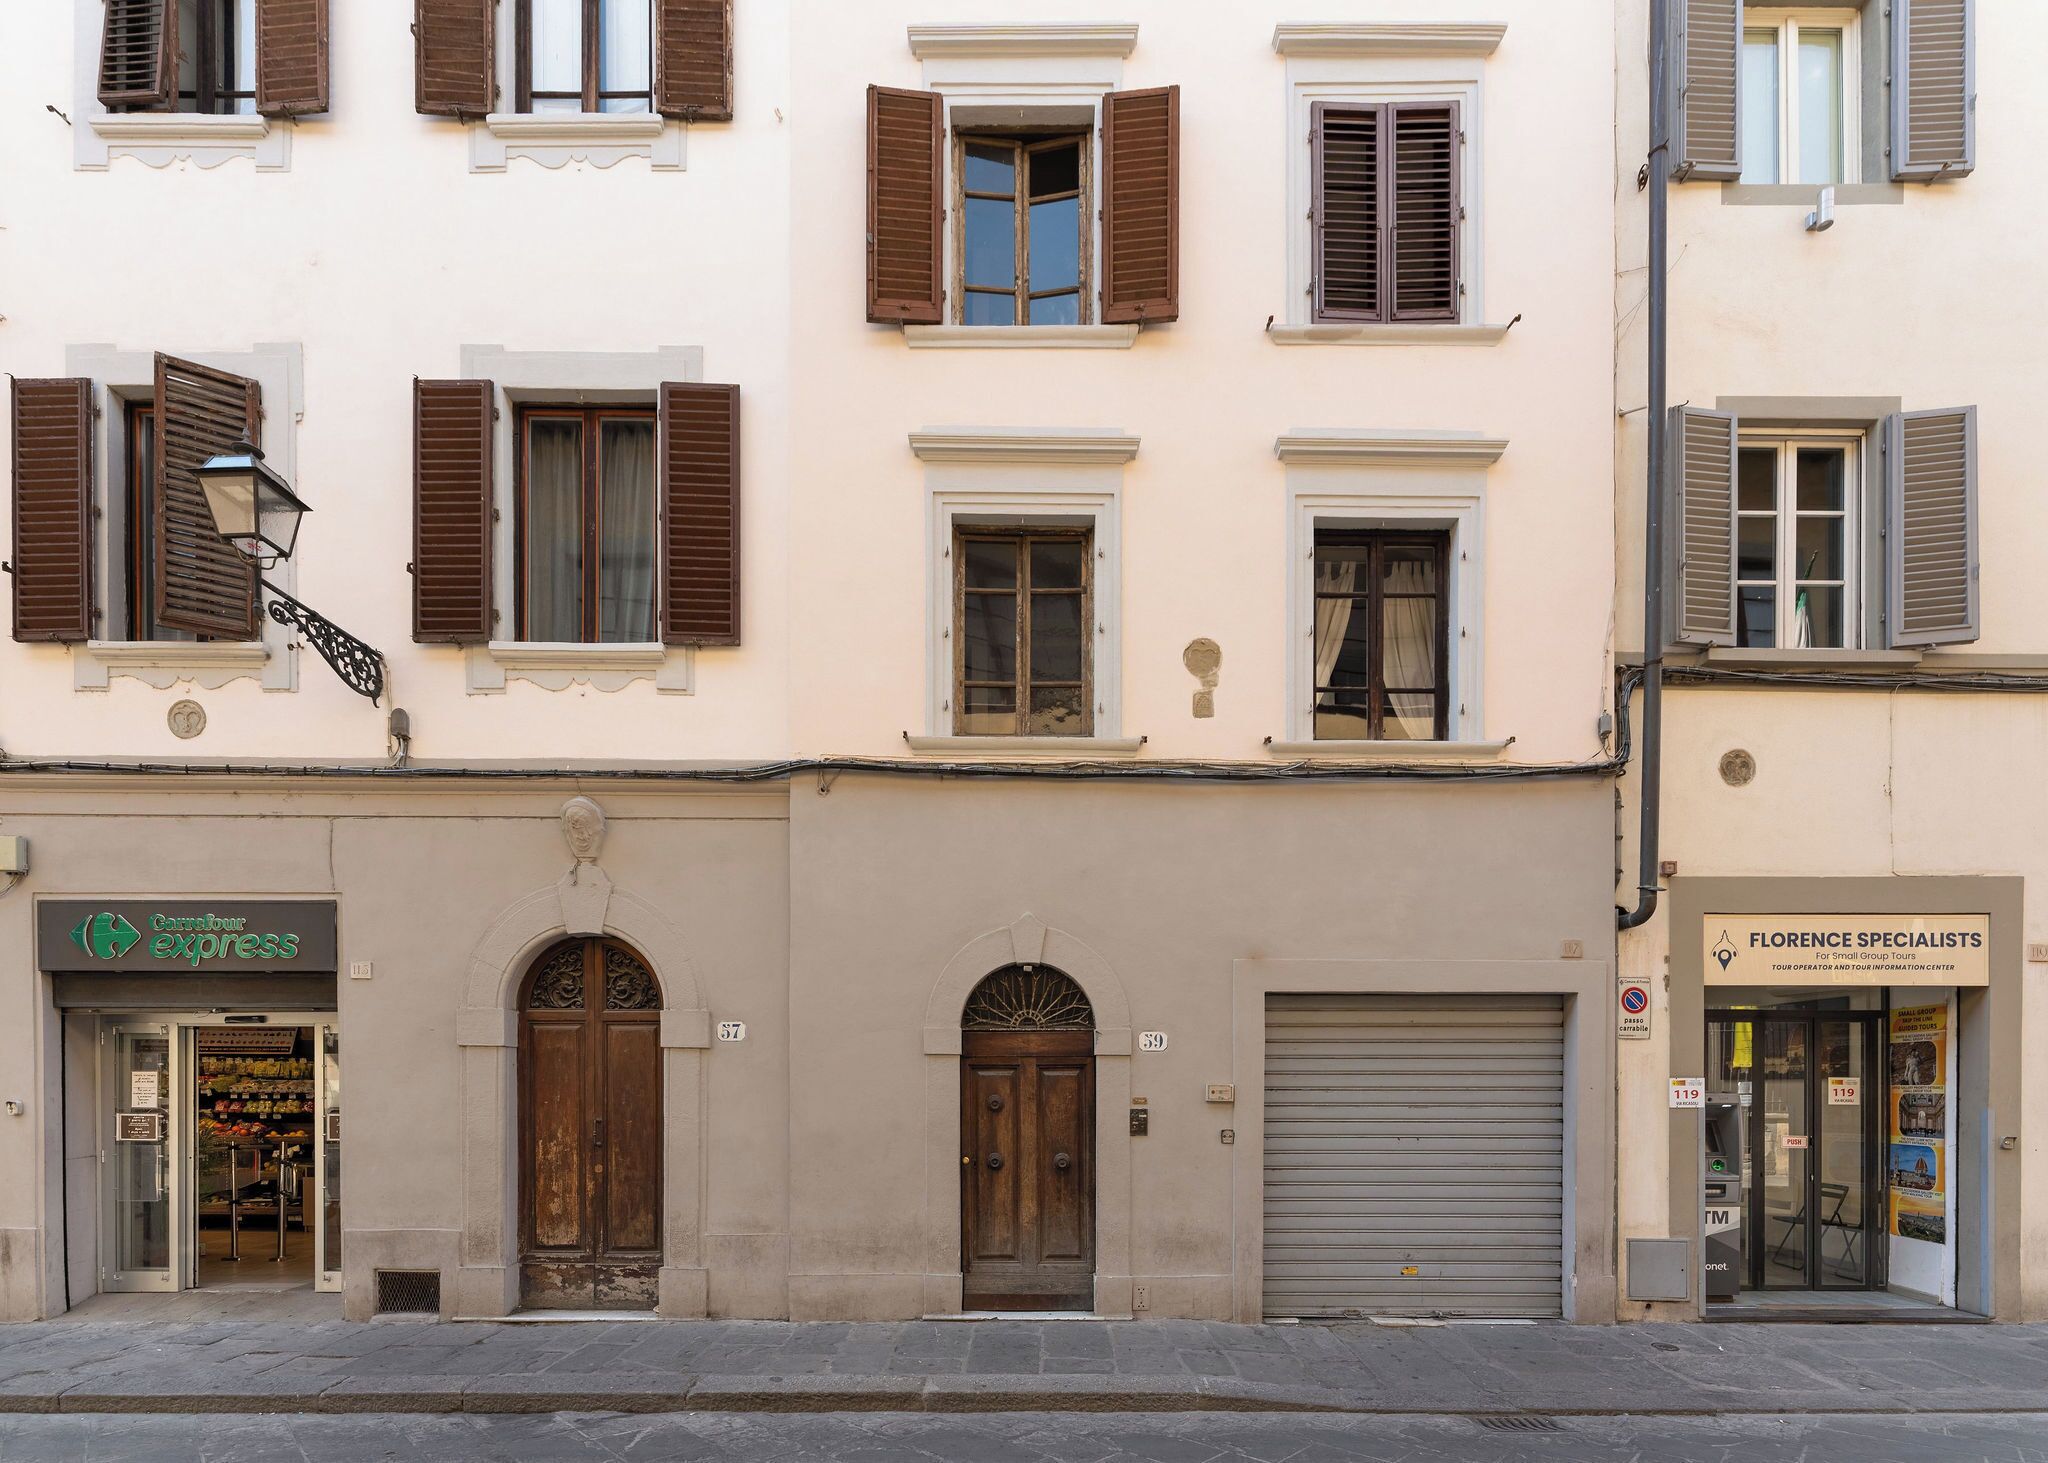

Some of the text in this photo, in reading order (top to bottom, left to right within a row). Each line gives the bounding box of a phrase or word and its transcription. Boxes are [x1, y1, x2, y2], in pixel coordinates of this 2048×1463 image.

[148, 913, 246, 931] Carrefour
[1749, 932, 1982, 948] FLORENCE SPECIALISTS
[148, 933, 300, 967] express
[1815, 951, 1916, 962] For Small Group Tours
[721, 1023, 741, 1039] 57
[1144, 1033, 1164, 1049] 59
[1674, 1089, 1699, 1099] 119
[1833, 1088, 1855, 1097] 119
[1705, 1210, 1729, 1225] TM
[1705, 1262, 1728, 1271] onet
